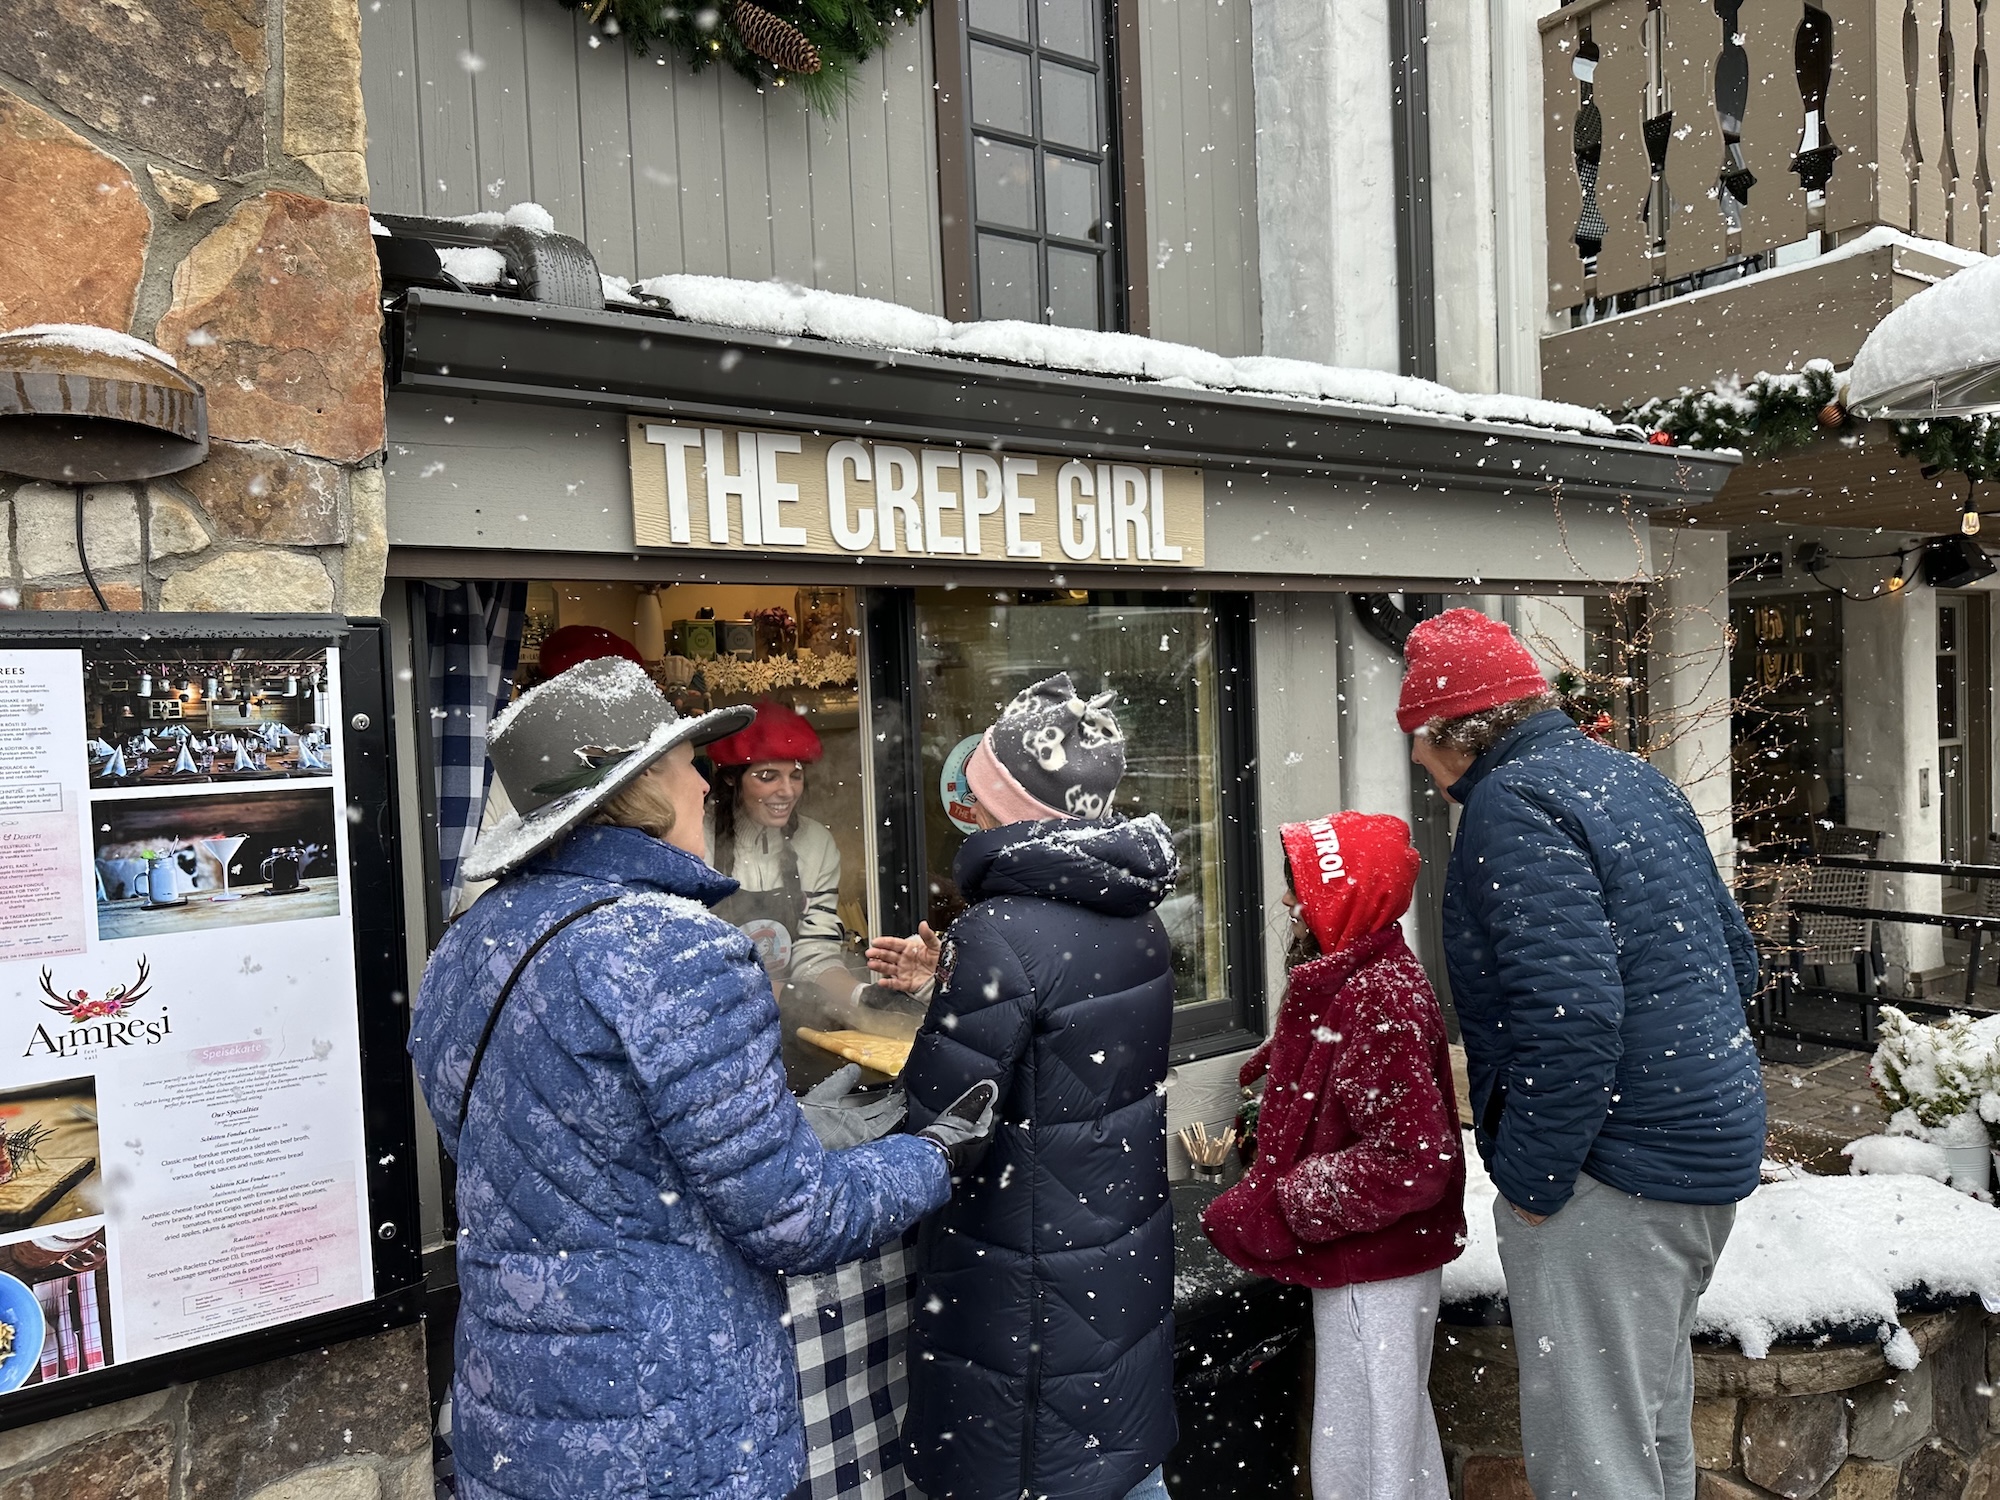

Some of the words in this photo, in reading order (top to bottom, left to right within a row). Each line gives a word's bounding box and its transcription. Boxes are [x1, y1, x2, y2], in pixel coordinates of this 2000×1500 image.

[646, 425, 806, 545] THE
[826, 441, 1041, 558] CREPE
[1057, 461, 1183, 561] GIRL
[954, 806, 968, 819] THE
[202, 1042, 262, 1060] Speisekarte
[226, 1106, 259, 1118] Specialties
[160, 1158, 181, 1166] Classic
[220, 1146, 240, 1155] served
[194, 1168, 216, 1176] dipping
[266, 1154, 286, 1163] Almresi
[287, 1150, 304, 1158] bread
[226, 1154, 252, 1163] potatoes,
[253, 1148, 281, 1157] tomatoes,
[141, 1210, 170, 1220] Authentic
[171, 1206, 192, 1214] cheese
[193, 1202, 214, 1210] fondue
[215, 1196, 241, 1206] prepared
[256, 1186, 288, 1197] Emmentaler
[243, 1199, 262, 1208] served
[302, 1188, 327, 1196] potatoes,
[164, 1232, 180, 1241] dried
[202, 1226, 220, 1234] plums
[280, 1208, 300, 1216] Almresi
[301, 1204, 317, 1212] bread
[182, 1219, 211, 1229] tomatoes,
[212, 1212, 237, 1222] steamed
[238, 1208, 265, 1217] vegetable
[147, 1269, 168, 1279] Served
[183, 1262, 207, 1270] Raclette
[208, 1256, 230, 1265] Cheese
[240, 1246, 274, 1258] Emmentaler
[275, 1242, 294, 1250] cheese
[172, 1272, 196, 1282] sausage
[222, 1261, 249, 1271] potatoes,
[250, 1254, 274, 1264] steamed
[274, 1248, 301, 1258] vegetable
[209, 1270, 241, 1282] cornichons
[248, 1264, 262, 1273] pearl
[262, 1261, 282, 1270] onions
